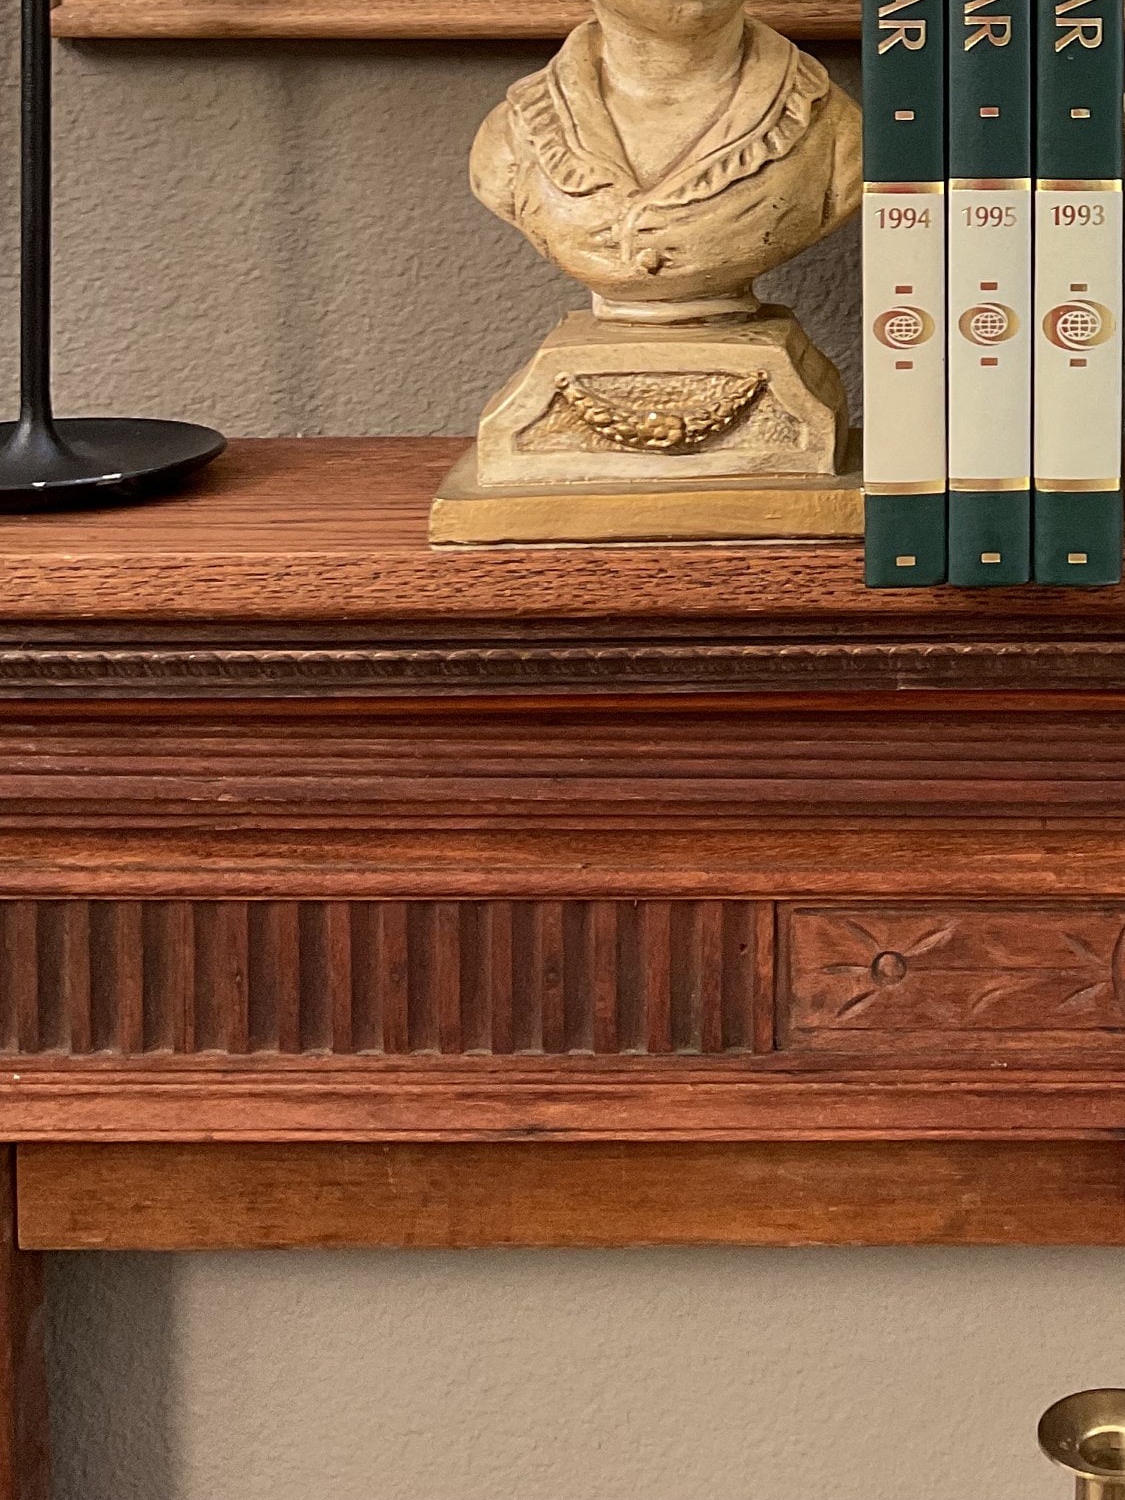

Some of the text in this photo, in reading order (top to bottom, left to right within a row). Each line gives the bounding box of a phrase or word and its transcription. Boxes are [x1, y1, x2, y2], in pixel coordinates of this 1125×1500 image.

[874, 207, 933, 230] 1994
[961, 204, 1018, 228] 1995
[1050, 204, 1106, 227] 1993
